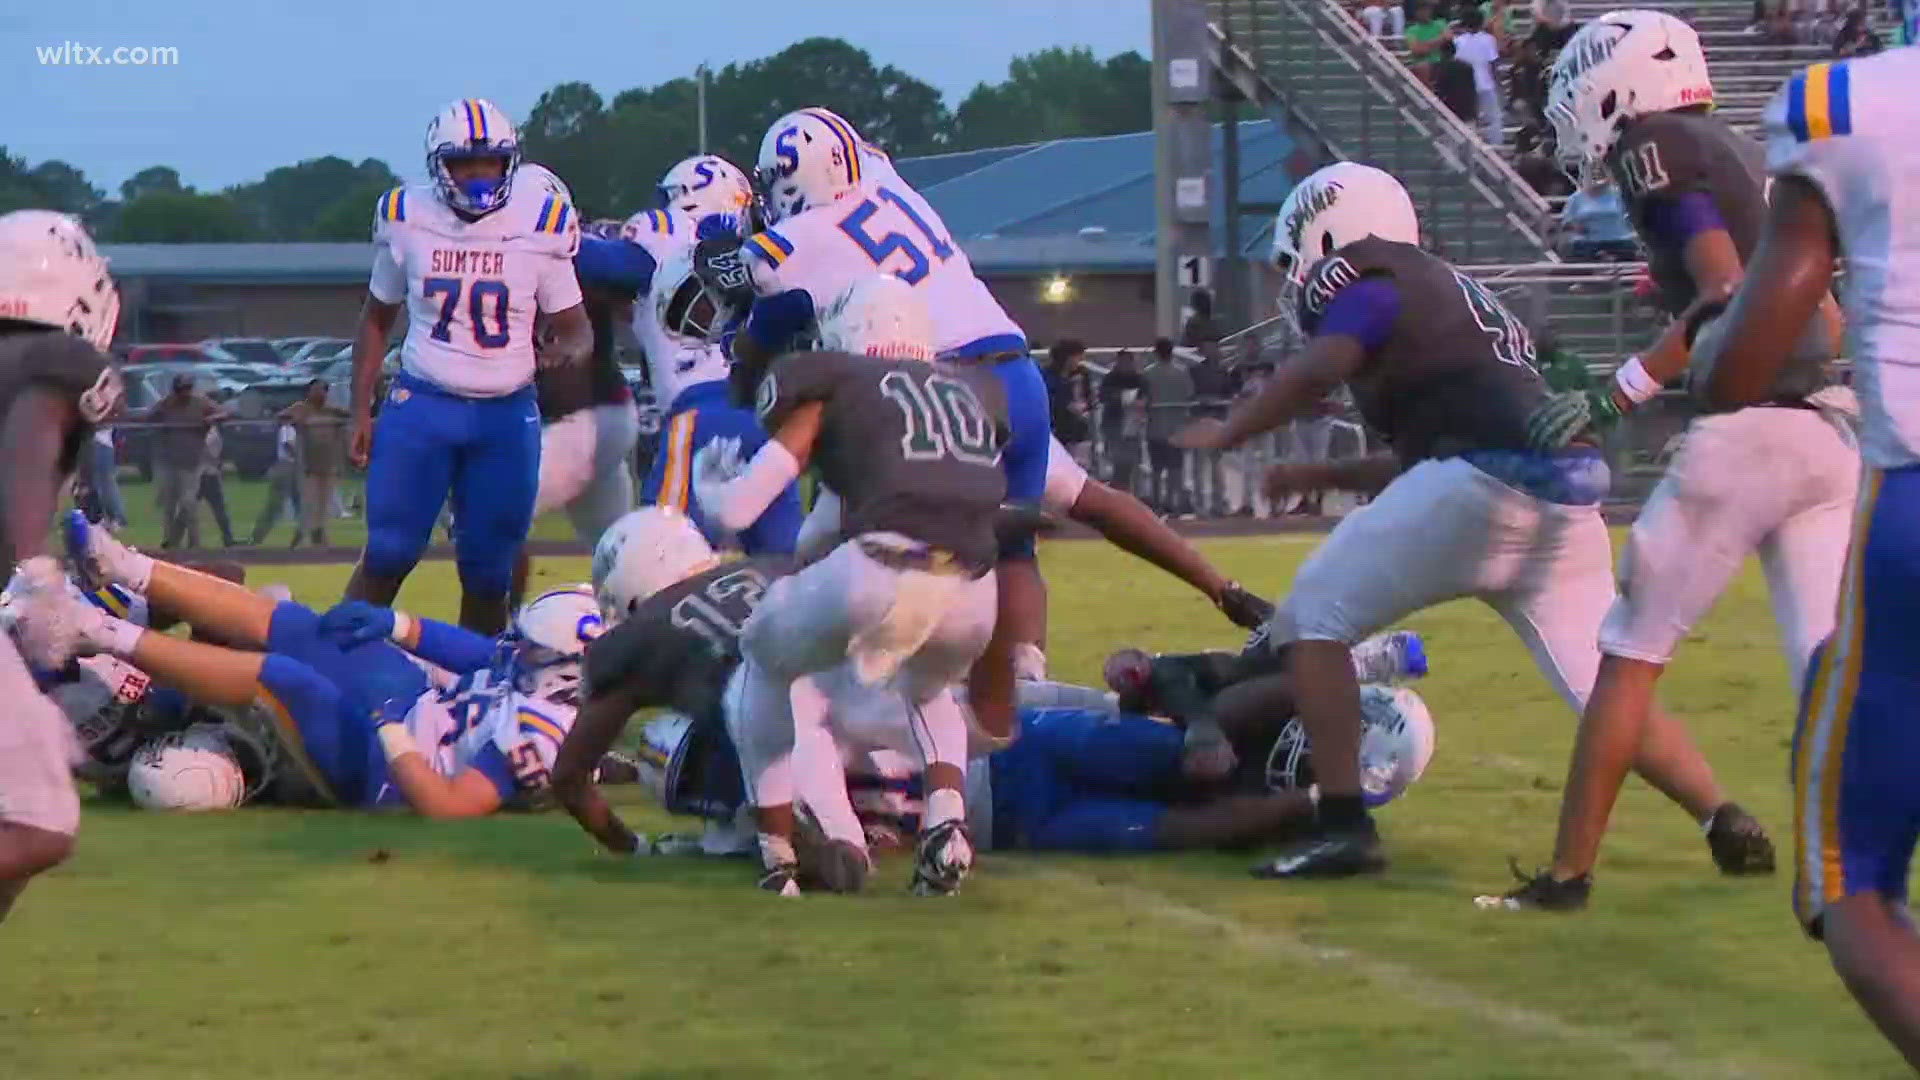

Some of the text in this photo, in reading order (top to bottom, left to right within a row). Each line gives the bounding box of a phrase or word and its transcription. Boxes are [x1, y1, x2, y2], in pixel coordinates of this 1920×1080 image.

[692, 160, 718, 191] S
[776, 125, 799, 177] S
[431, 249, 504, 275] SUMTER
[836, 187, 954, 287] 51
[1183, 257, 1200, 286] 1
[423, 276, 511, 350] 70
[879, 370, 1003, 468] 10
